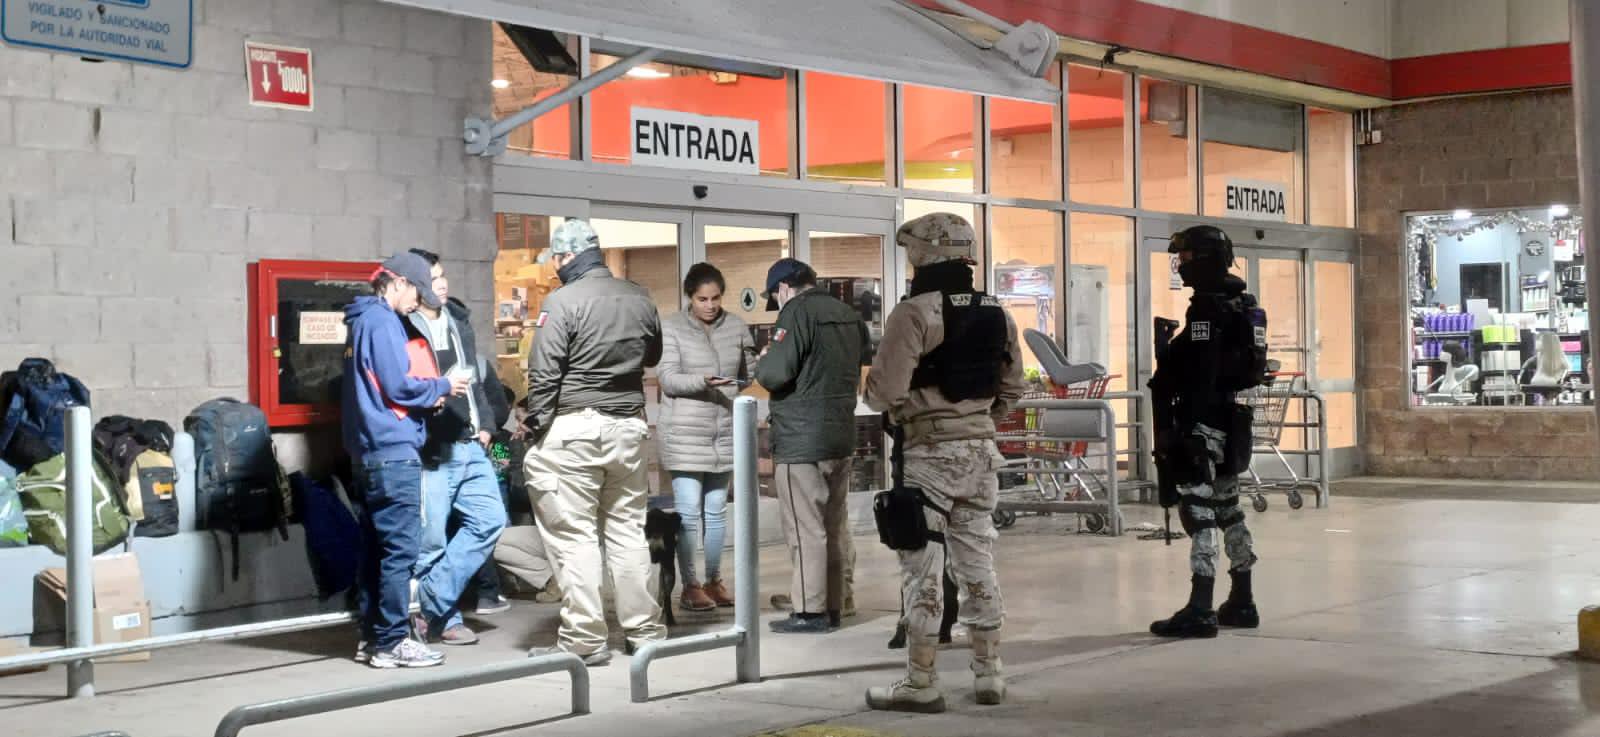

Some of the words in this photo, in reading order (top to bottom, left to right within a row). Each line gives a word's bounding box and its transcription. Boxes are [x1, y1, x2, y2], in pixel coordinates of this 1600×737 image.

[28, 2, 82, 21] VIGILADO
[87, 10, 96, 21] Y
[99, 14, 170, 35] SANCIONADO
[30, 20, 55, 35] POR
[60, 24, 75, 38] LA
[79, 27, 141, 48] AUTORIDAD
[145, 40, 168, 53] VIAL
[635, 119, 755, 165] ENTRADA
[1226, 185, 1286, 215] ENTRADA
